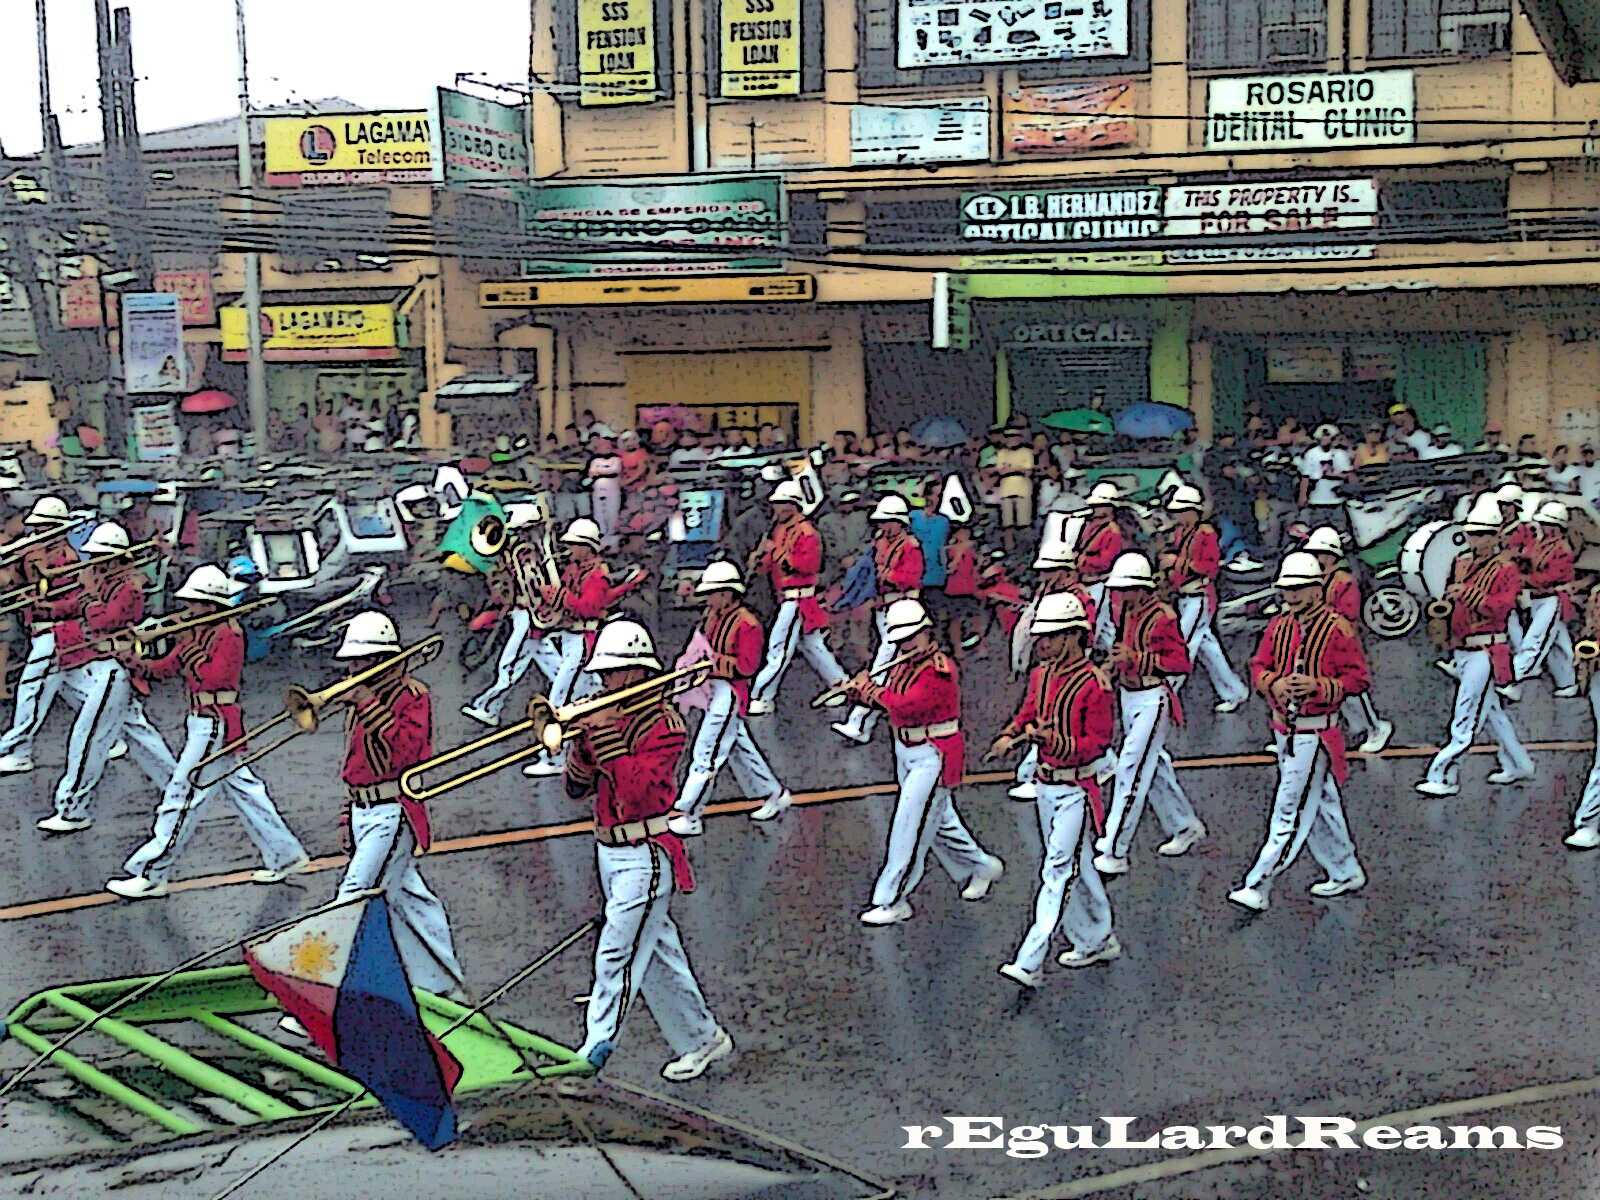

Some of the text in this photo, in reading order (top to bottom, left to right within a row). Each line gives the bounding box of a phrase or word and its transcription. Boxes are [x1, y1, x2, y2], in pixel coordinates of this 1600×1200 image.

[730, 20, 791, 42] PENSION
[1247, 78, 1374, 105] ROSARIO
[1213, 108, 1406, 142] DENTAL CLINIC
[357, 148, 430, 165] Telecom
[1047, 191, 1160, 218] HERNANDEZ
[1184, 189, 1222, 207] THIS
[1228, 186, 1327, 206] PROPERTY
[1201, 207, 1339, 233] FOR SALE
